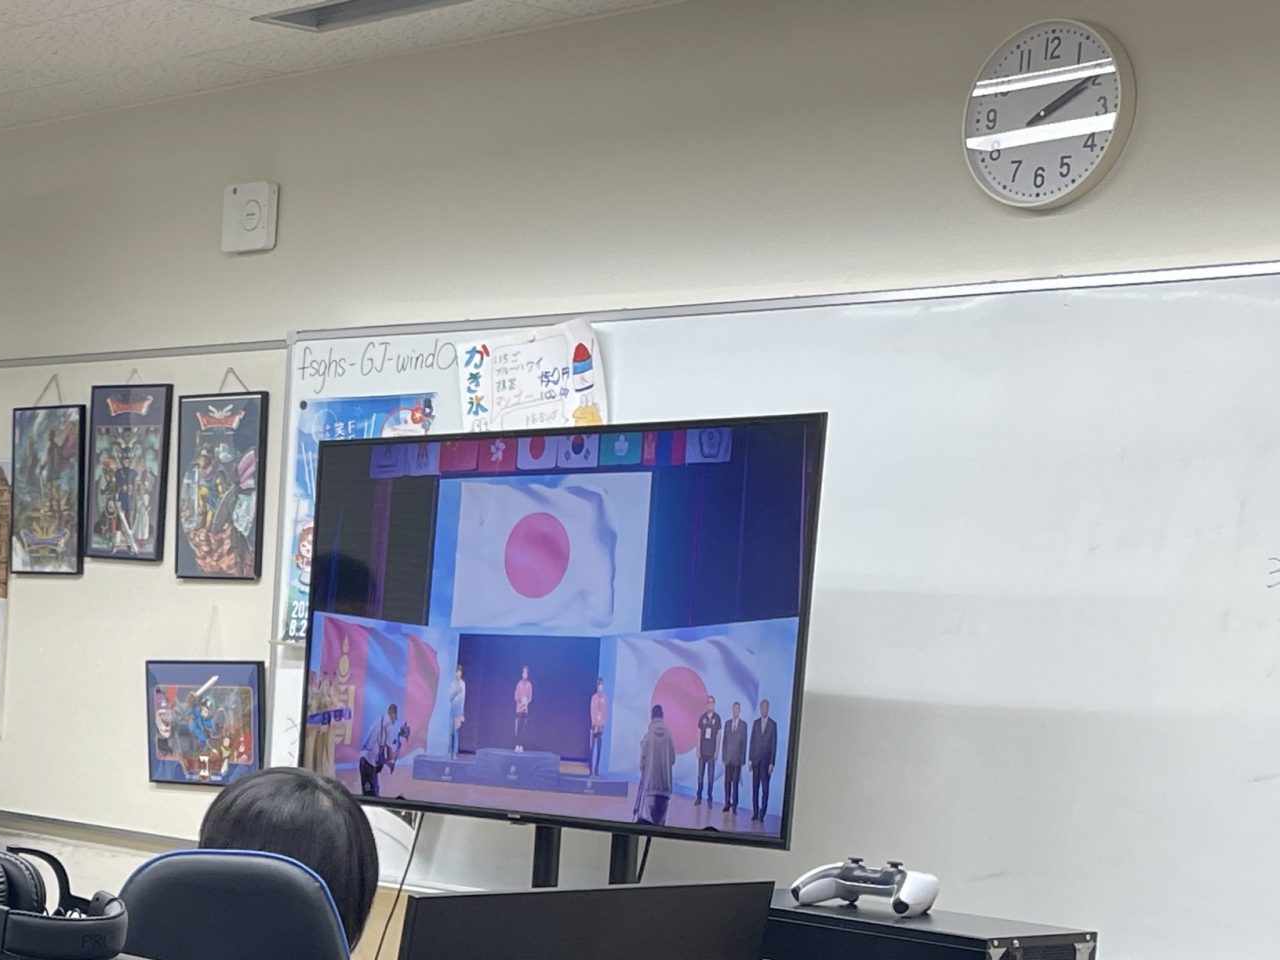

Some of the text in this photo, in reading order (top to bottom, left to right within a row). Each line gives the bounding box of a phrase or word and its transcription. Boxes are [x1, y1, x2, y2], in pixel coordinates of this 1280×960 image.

[1019, 49, 1032, 72] 11
[1044, 37, 1062, 61] 12
[1095, 96, 1108, 117] 3
[986, 109, 997, 130] 9
[1083, 132, 1097, 152] 4
[1010, 160, 1023, 183] 7
[1033, 167, 1046, 189] 6
[1059, 155, 1072, 178] 5
[465, 344, 490, 416] かき氷
